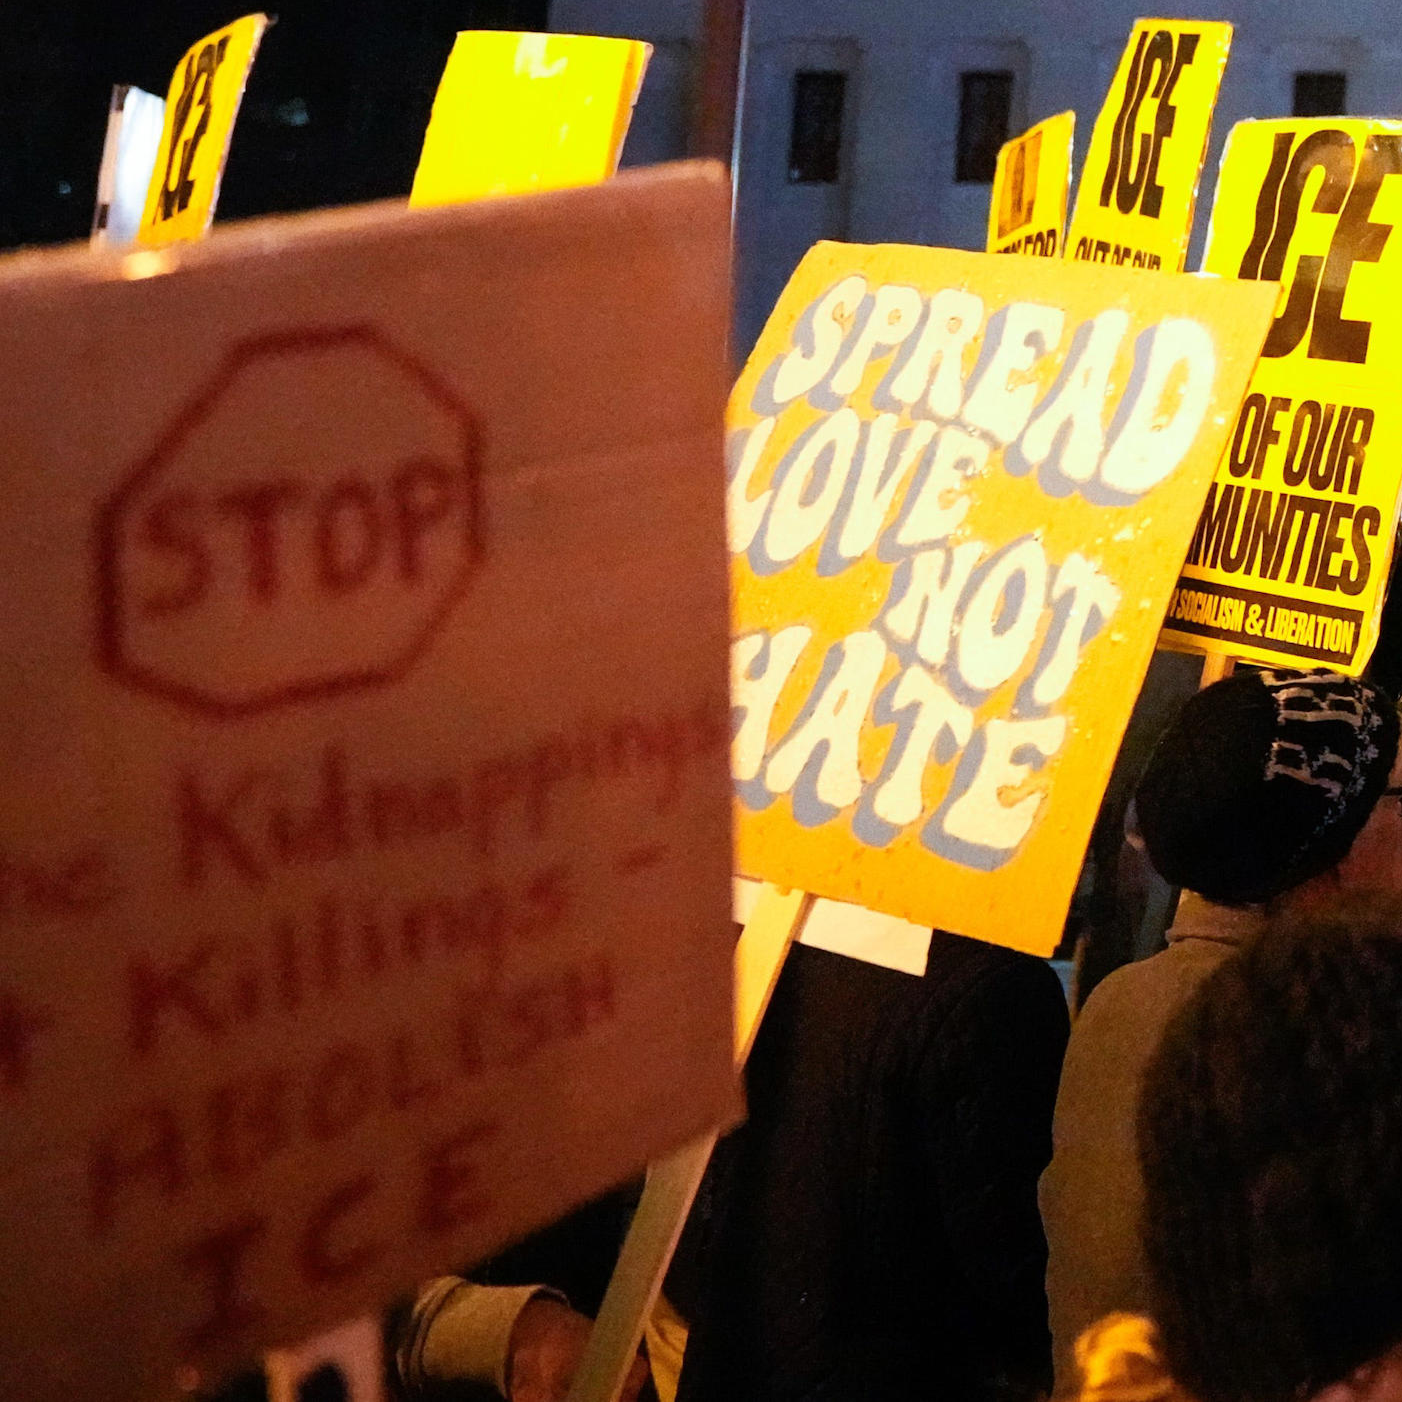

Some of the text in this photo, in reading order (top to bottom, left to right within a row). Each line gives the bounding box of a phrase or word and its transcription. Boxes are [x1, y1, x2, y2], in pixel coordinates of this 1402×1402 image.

[1099, 30, 1200, 220] ICE
[755, 275, 1216, 505] SPREAD
[1229, 393, 1375, 494] OF OUR
[141, 456, 457, 618] STOP
[728, 409, 994, 577] LOVE
[1186, 482, 1381, 596] MUNITIES
[876, 534, 1122, 717] NOT
[1175, 587, 1246, 633] SOCIALISM
[1244, 604, 1264, 637] &
[1264, 606, 1355, 654] LIBERATION
[731, 625, 1067, 871] HATE
[126, 866, 574, 1060] Killings
[88, 961, 618, 1238] ABOLISH
[178, 1125, 498, 1358] ICE
